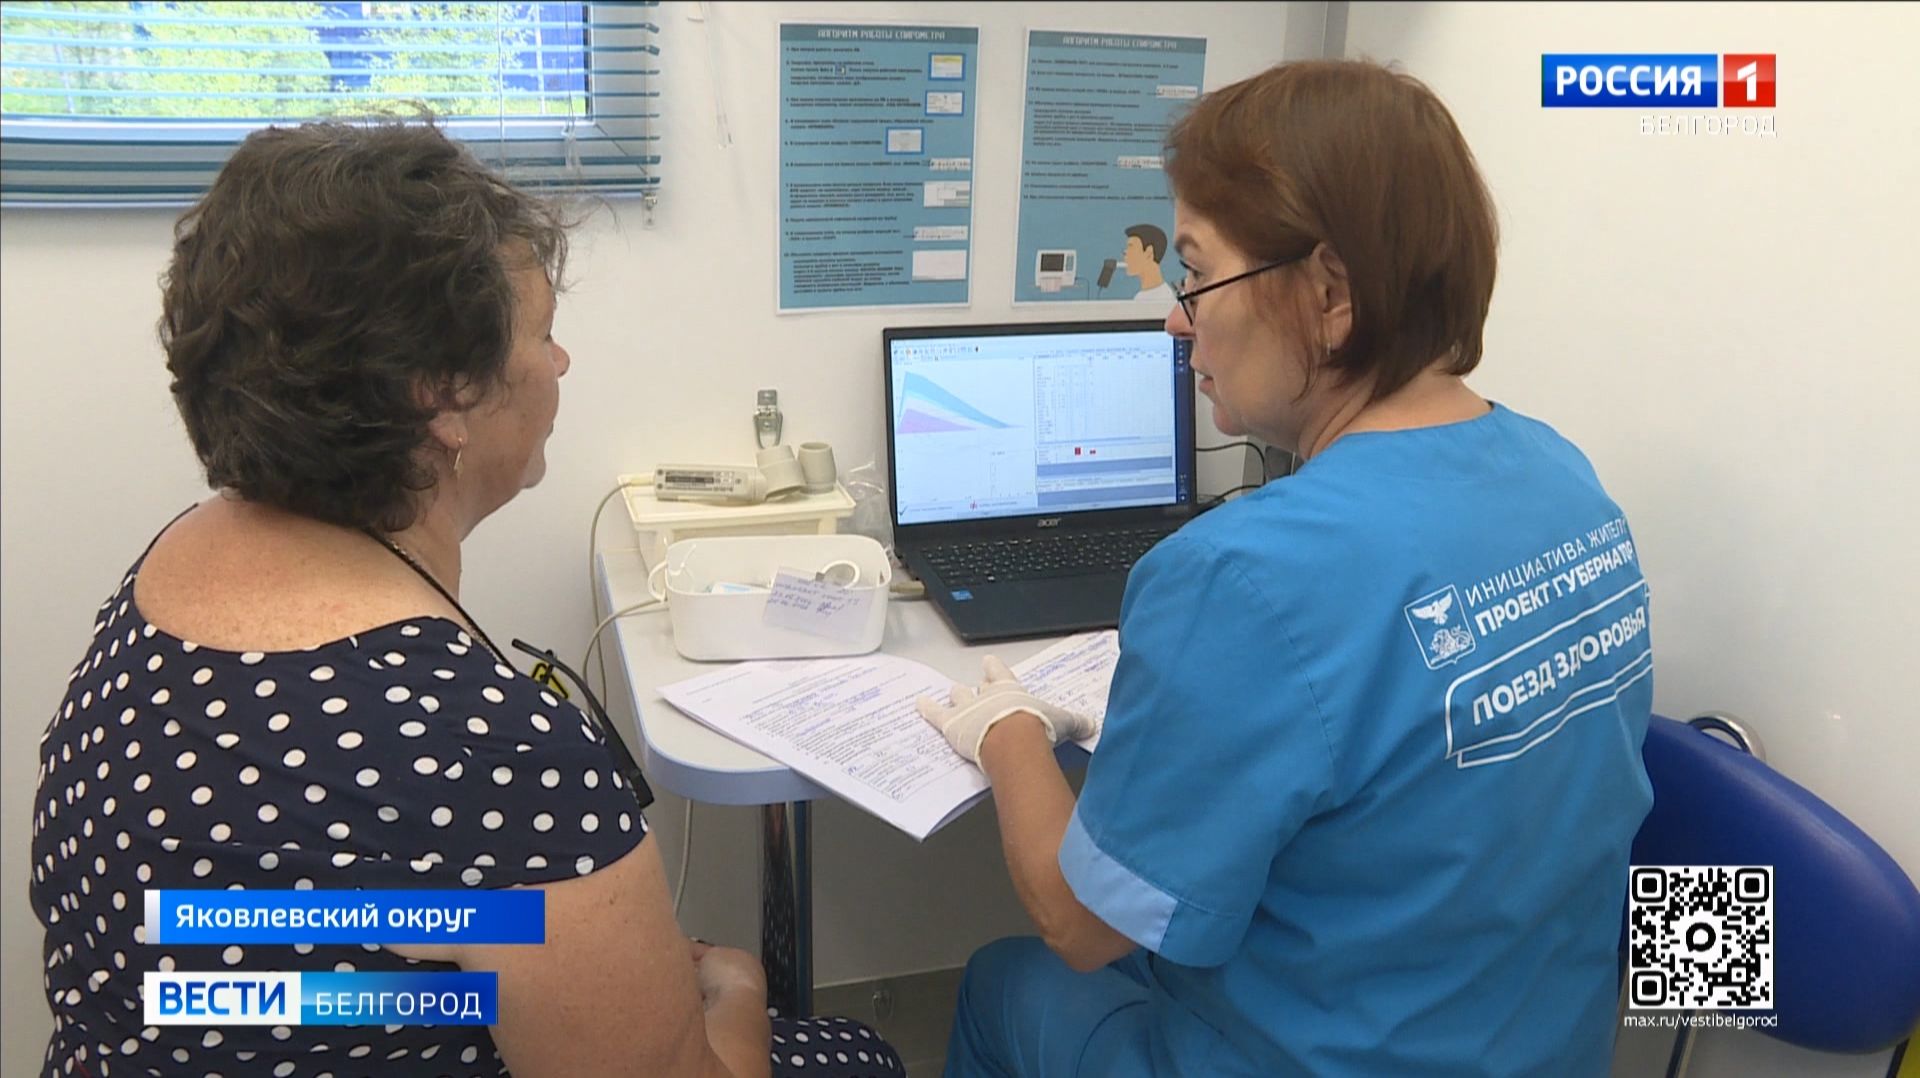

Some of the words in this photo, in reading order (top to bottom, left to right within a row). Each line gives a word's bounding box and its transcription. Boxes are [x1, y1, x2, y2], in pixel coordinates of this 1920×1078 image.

[1037, 517, 1062, 528] acer
[1465, 537, 1587, 608] ИНИЦИАТИВА
[1474, 581, 1550, 637] ПРОЕКТ
[1472, 659, 1556, 726] ПОЕЗД
[1554, 605, 1646, 679] ЗДОРОВЬЯ
